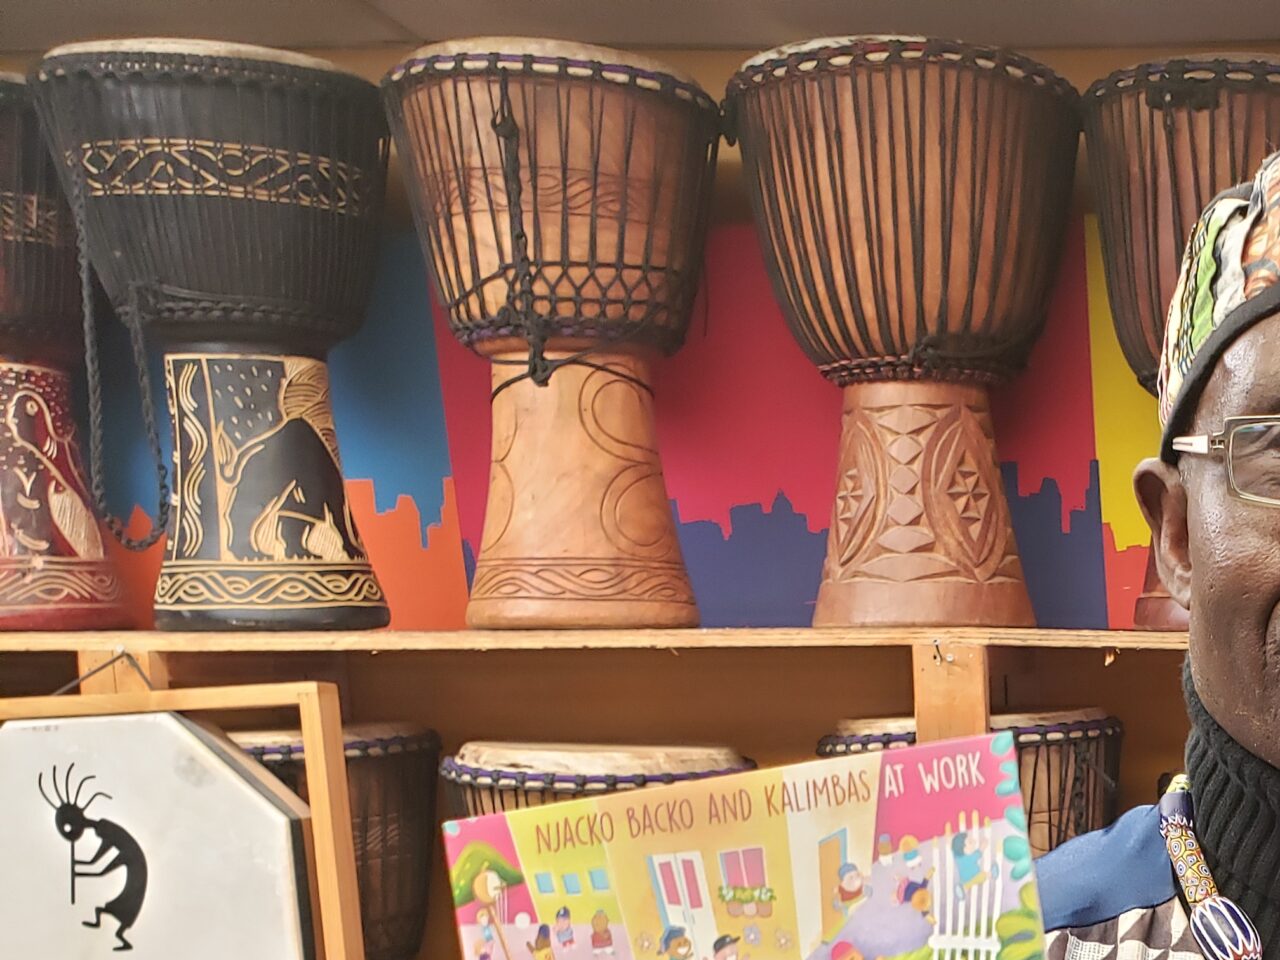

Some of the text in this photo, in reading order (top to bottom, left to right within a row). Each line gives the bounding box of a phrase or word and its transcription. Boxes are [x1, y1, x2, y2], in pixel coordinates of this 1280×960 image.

[535, 751, 985, 855] NJACKO BACKO AND KALIMBAS AT WORK
